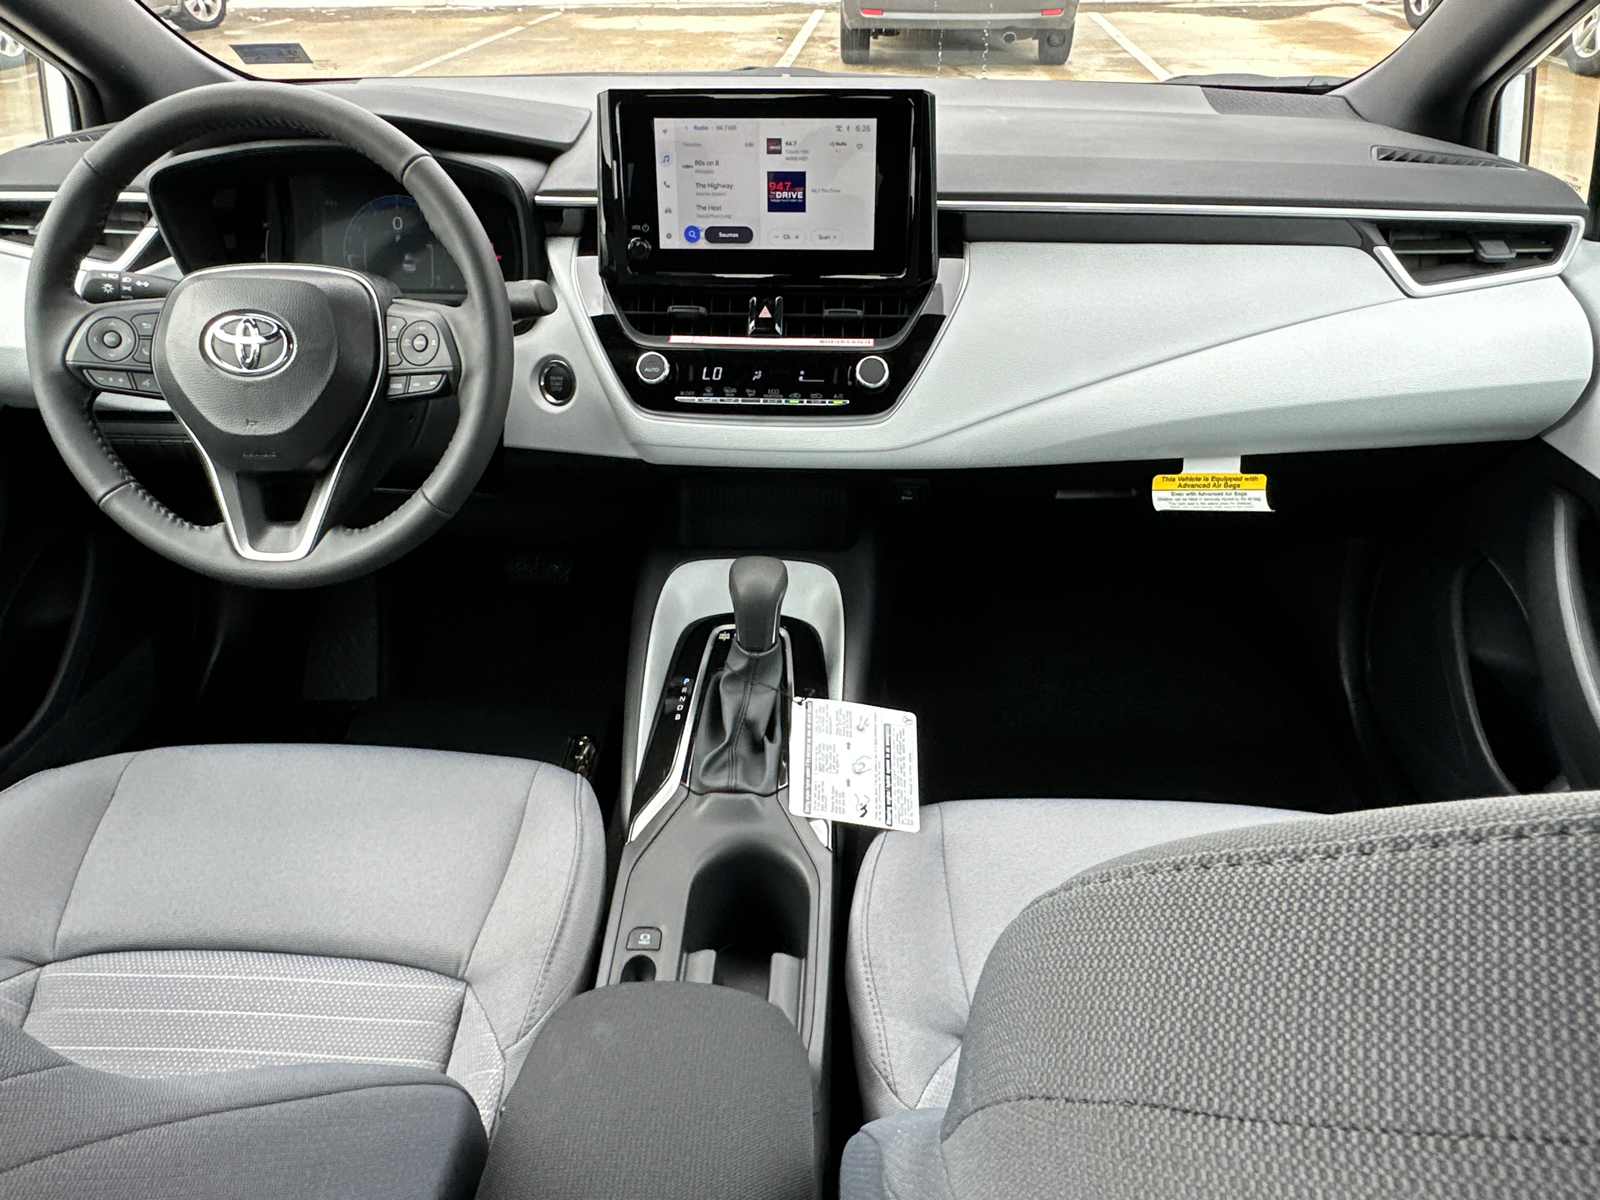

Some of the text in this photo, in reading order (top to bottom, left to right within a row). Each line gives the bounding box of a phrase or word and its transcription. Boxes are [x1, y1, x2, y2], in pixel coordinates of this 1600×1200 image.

[707, 182, 733, 190] Highway
[769, 181, 791, 191] 94.7
[392, 216, 403, 231] 0
[702, 366, 723, 380] LO
[1211, 474, 1243, 484] Equipped
[1224, 482, 1241, 490] Bags
